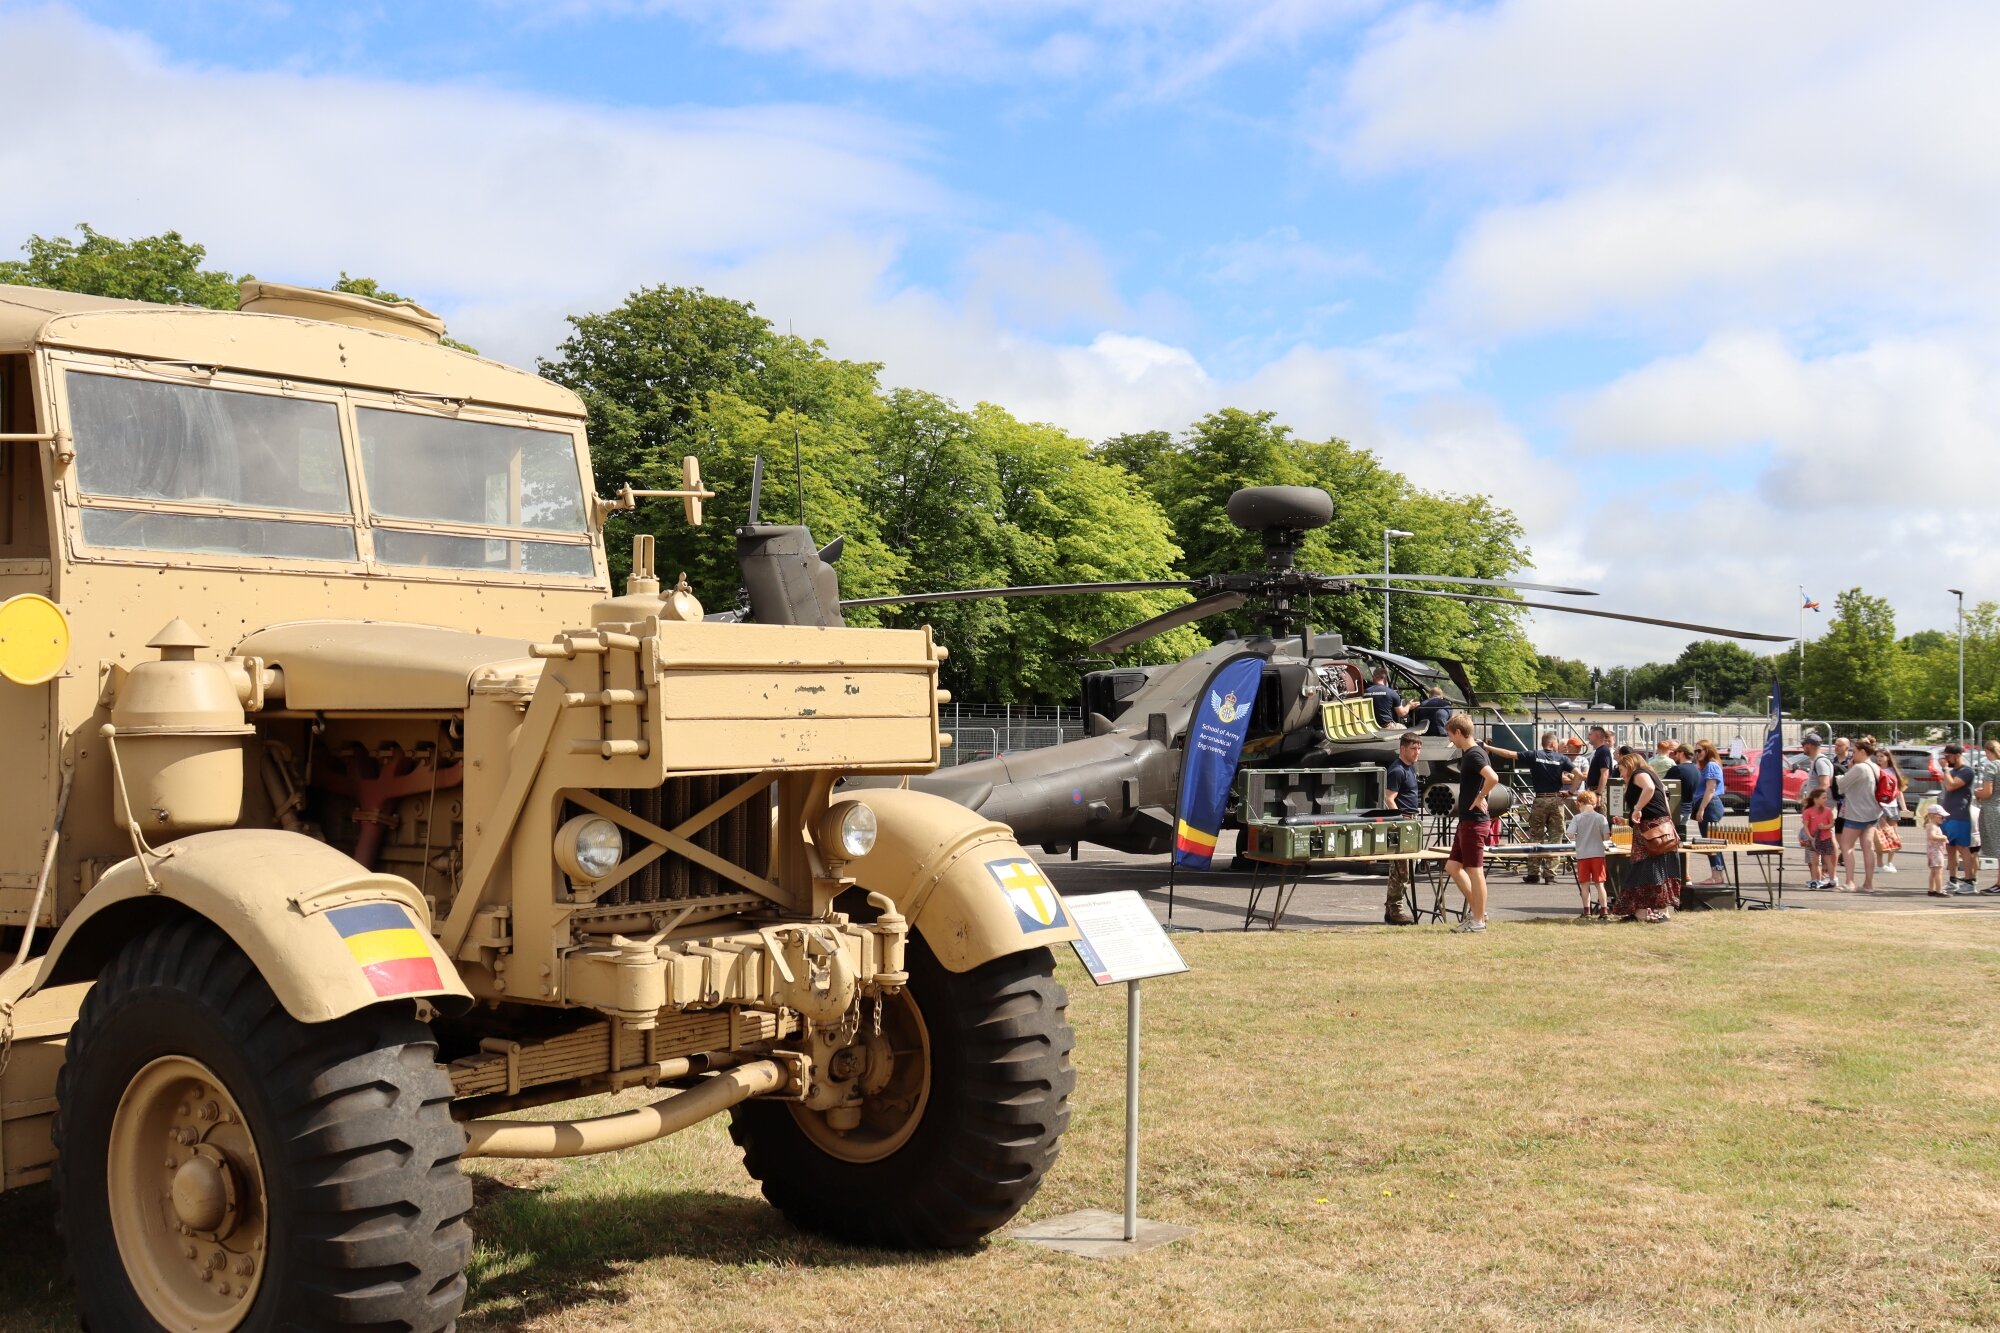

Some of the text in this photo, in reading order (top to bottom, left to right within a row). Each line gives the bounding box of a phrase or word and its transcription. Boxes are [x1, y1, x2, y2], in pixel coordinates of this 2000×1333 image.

[1202, 723, 1219, 733] School
[1225, 731, 1240, 741] Army
[1199, 733, 1232, 747] Aeronautical
[1197, 742, 1227, 756] Engineering
